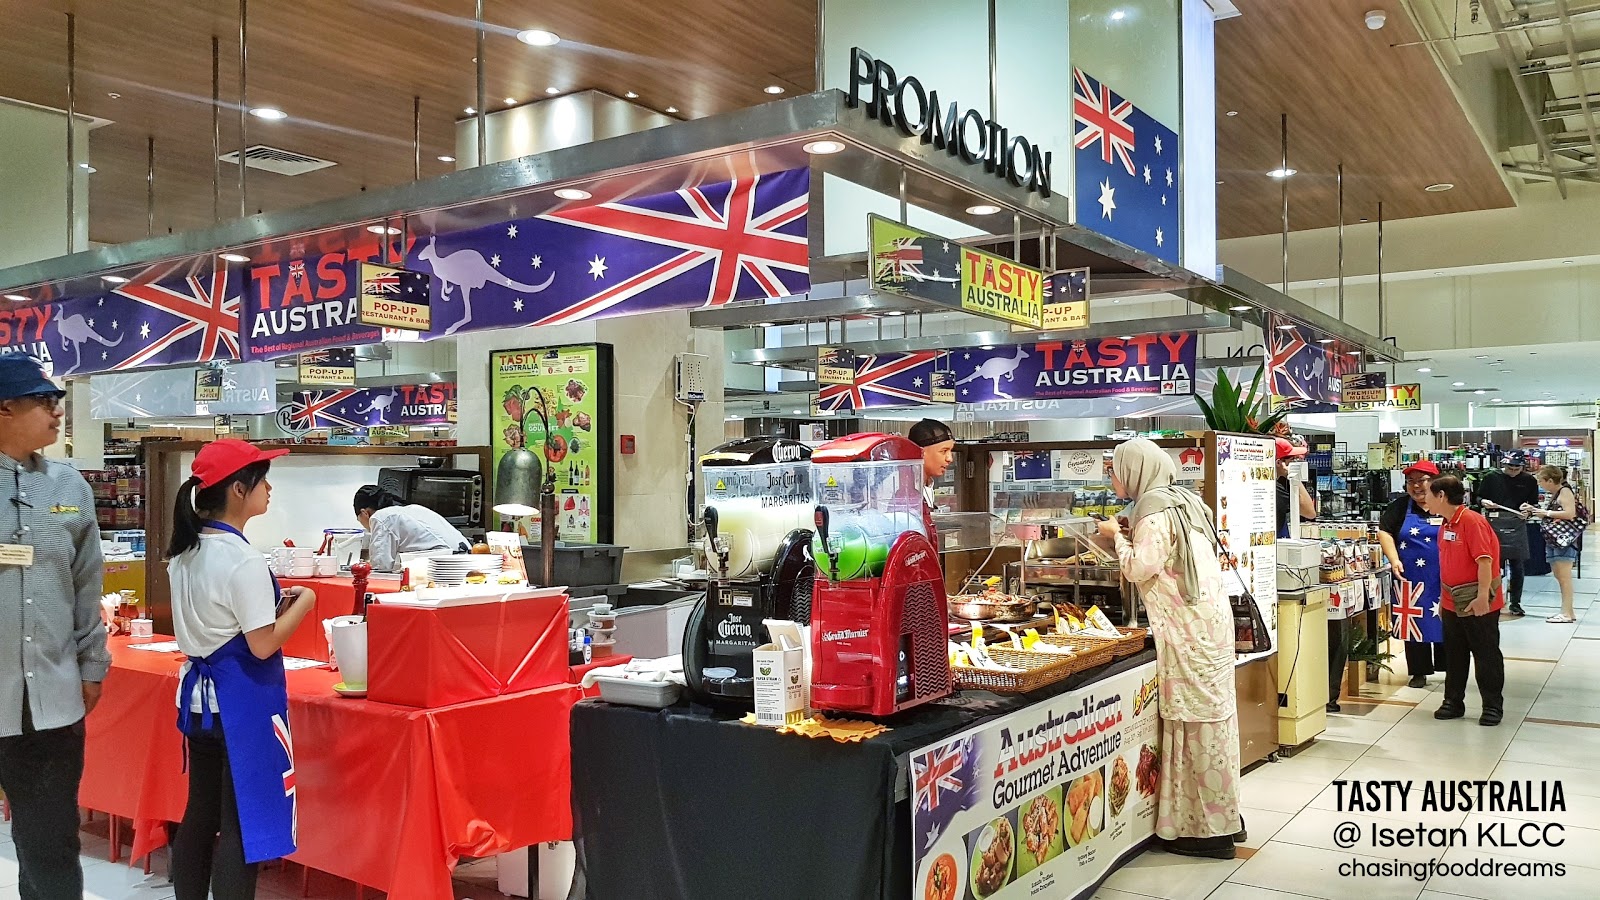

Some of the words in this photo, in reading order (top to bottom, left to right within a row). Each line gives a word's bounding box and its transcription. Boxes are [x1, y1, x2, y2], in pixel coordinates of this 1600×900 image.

[849, 46, 1052, 198] PROMOTION
[965, 250, 1040, 302] TASTY
[374, 302, 418, 316] POP-UP
[966, 285, 1040, 320] AUSTRALIA
[1043, 306, 1072, 315] P-UP
[0, 304, 52, 345] STY
[251, 297, 357, 338] AUSTRA
[251, 346, 263, 354] The
[264, 344, 275, 353] Best
[282, 341, 305, 351] Regional
[305, 337, 332, 347] Australian
[333, 335, 346, 343] Food
[351, 330, 380, 341] Beverages
[1035, 331, 1190, 370] TASTY
[499, 353, 538, 365] TASTY
[499, 364, 539, 372] AUSTRALIA
[824, 368, 848, 376] POP-UP
[1035, 363, 1190, 387] AUSTRALIA
[401, 384, 457, 405] TAST
[401, 404, 446, 417] AUSTRA
[772, 440, 801, 463] Cuervo
[761, 493, 810, 508] MARGARITAS
[718, 619, 753, 638] Cuervo
[728, 613, 742, 624] Jose
[994, 694, 1123, 779] Australian
[993, 755, 1055, 809] Gourmet
[1057, 731, 1121, 778] Adventure
